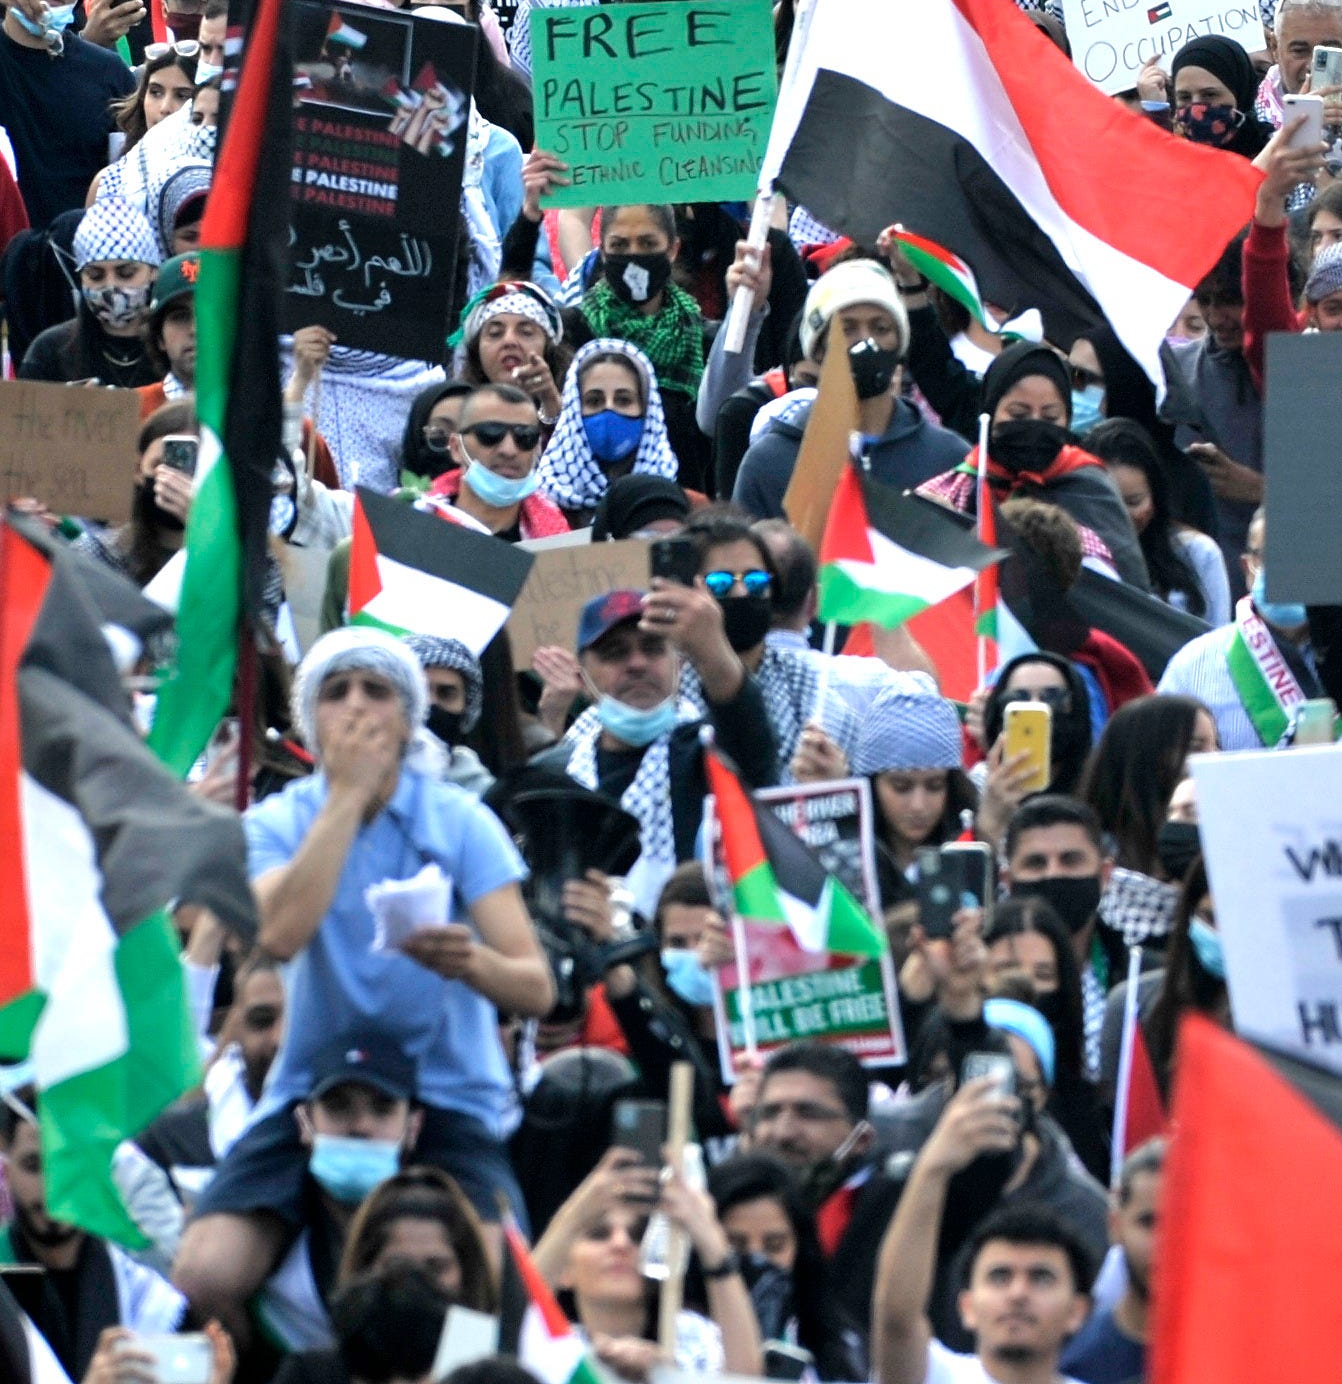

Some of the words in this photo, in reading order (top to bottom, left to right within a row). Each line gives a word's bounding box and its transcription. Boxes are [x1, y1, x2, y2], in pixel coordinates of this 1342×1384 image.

[547, 10, 735, 62] FREE
[541, 70, 769, 118] PALESTINE
[554, 118, 630, 154] STOP
[652, 115, 758, 149] FUNDING
[305, 172, 399, 201] PALESTINE
[572, 157, 645, 186] ETHNIC
[1242, 616, 1297, 706] ESTINE
